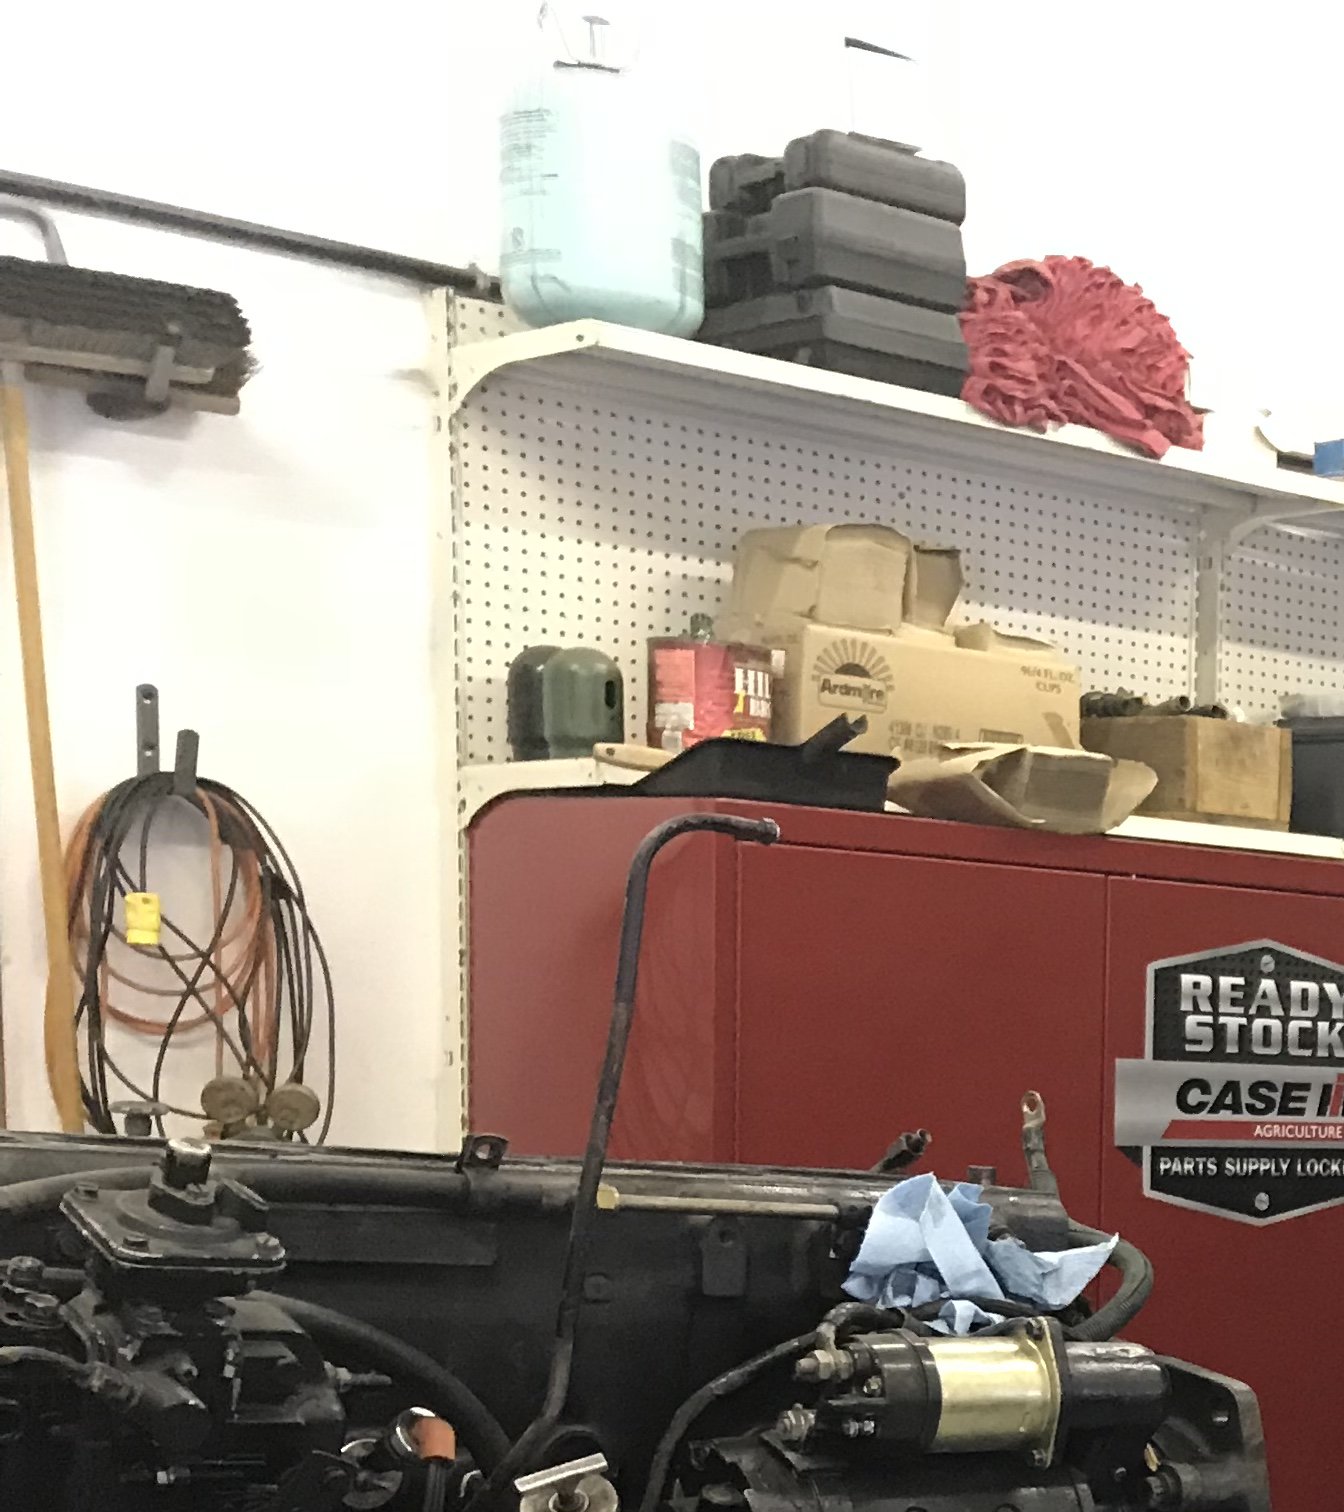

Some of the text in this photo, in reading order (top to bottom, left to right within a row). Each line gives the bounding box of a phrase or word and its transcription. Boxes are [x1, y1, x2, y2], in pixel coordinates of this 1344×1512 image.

[1175, 1077, 1312, 1116] CASE
[1253, 1124, 1344, 1139] AGRICULTURE
[1158, 1156, 1218, 1177] PARTS
[1224, 1157, 1291, 1178] SUPPLY
